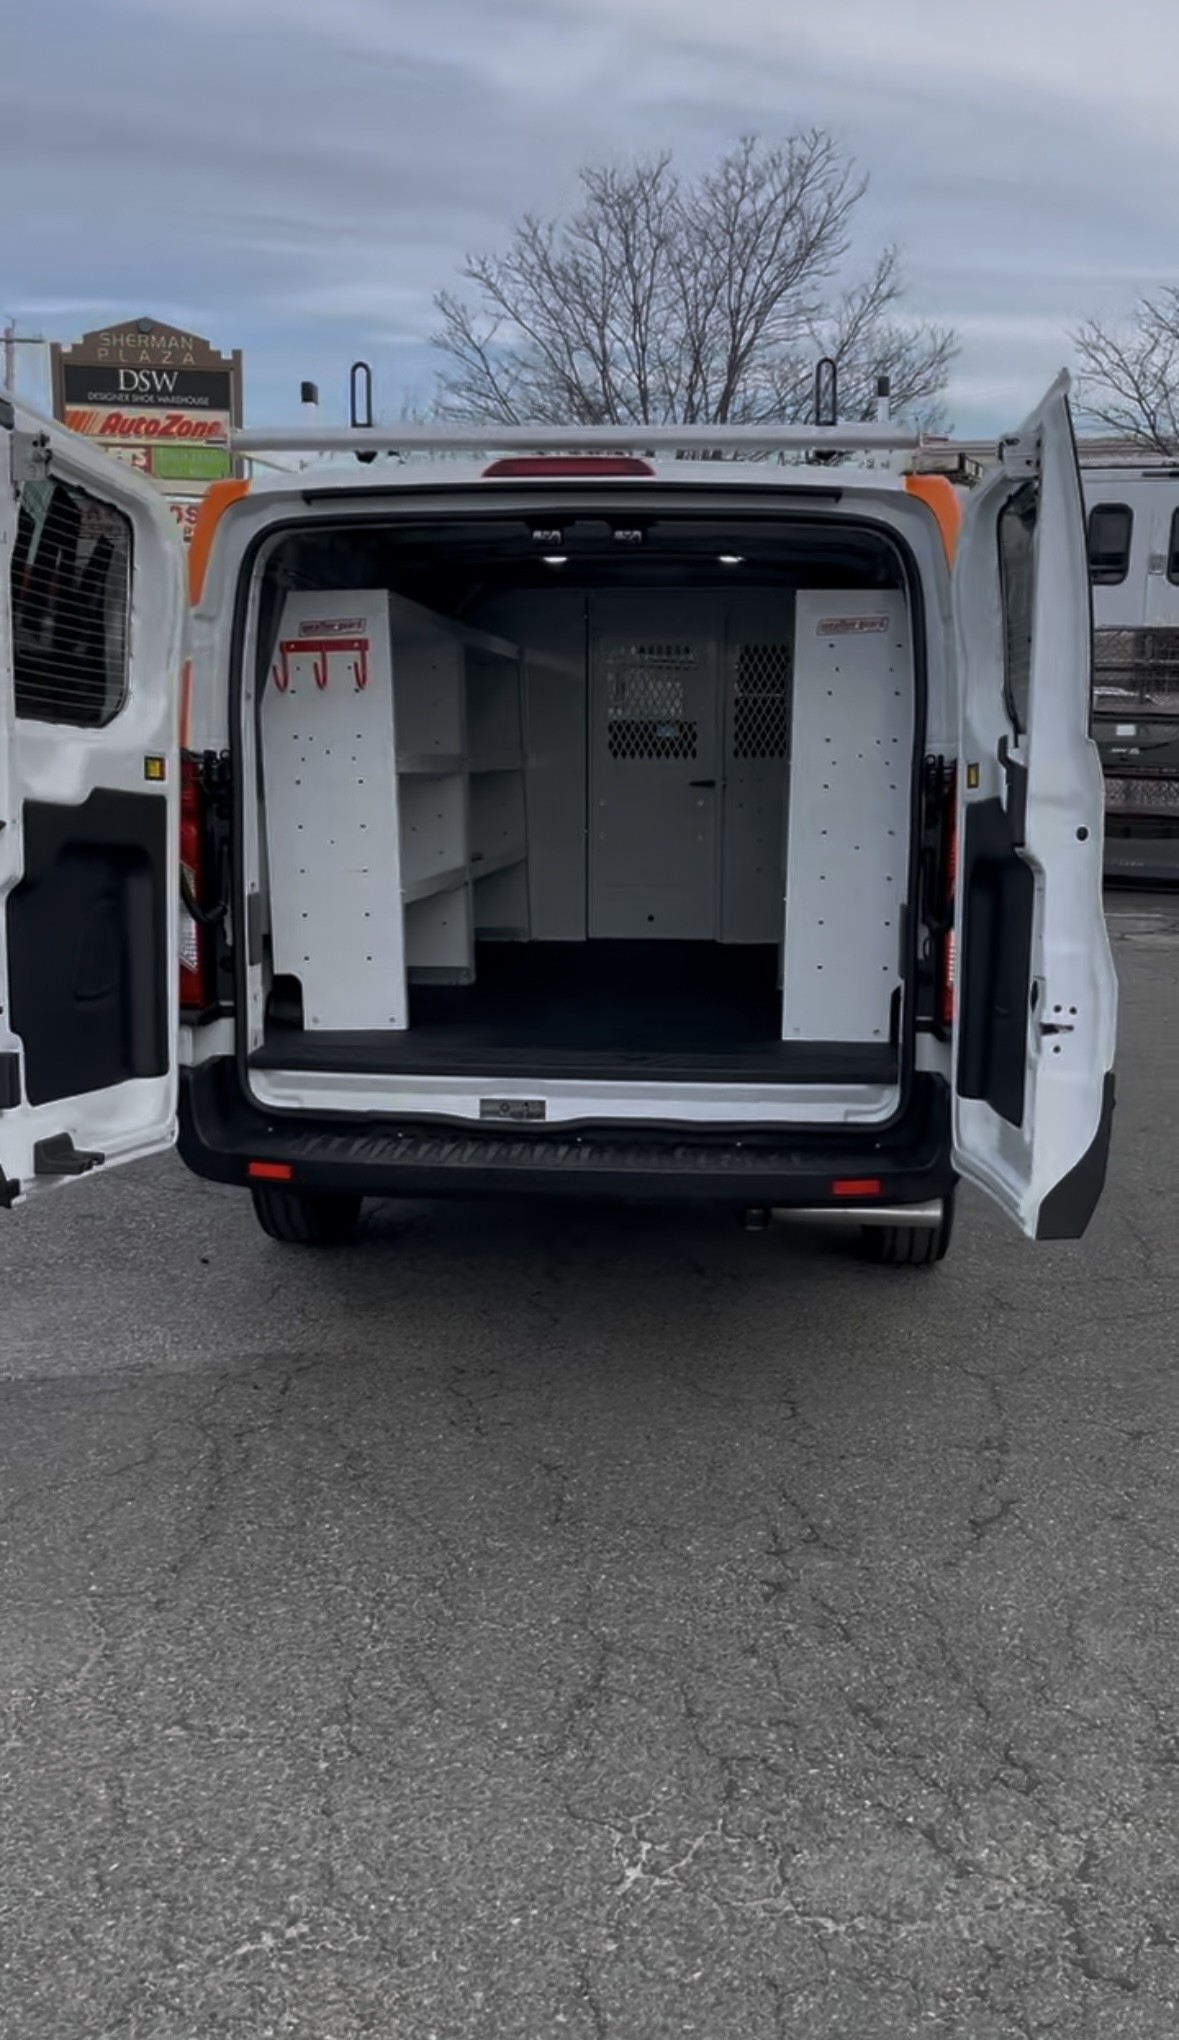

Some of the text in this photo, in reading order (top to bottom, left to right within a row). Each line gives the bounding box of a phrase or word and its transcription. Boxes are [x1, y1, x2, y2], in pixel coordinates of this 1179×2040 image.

[100, 333, 194, 350] SHERMAN
[98, 348, 195, 364] PLAZA
[119, 369, 178, 392] DSW
[88, 393, 209, 405] DESIGNER SHOE WAREHOUSE
[100, 411, 224, 438] AutoZone
